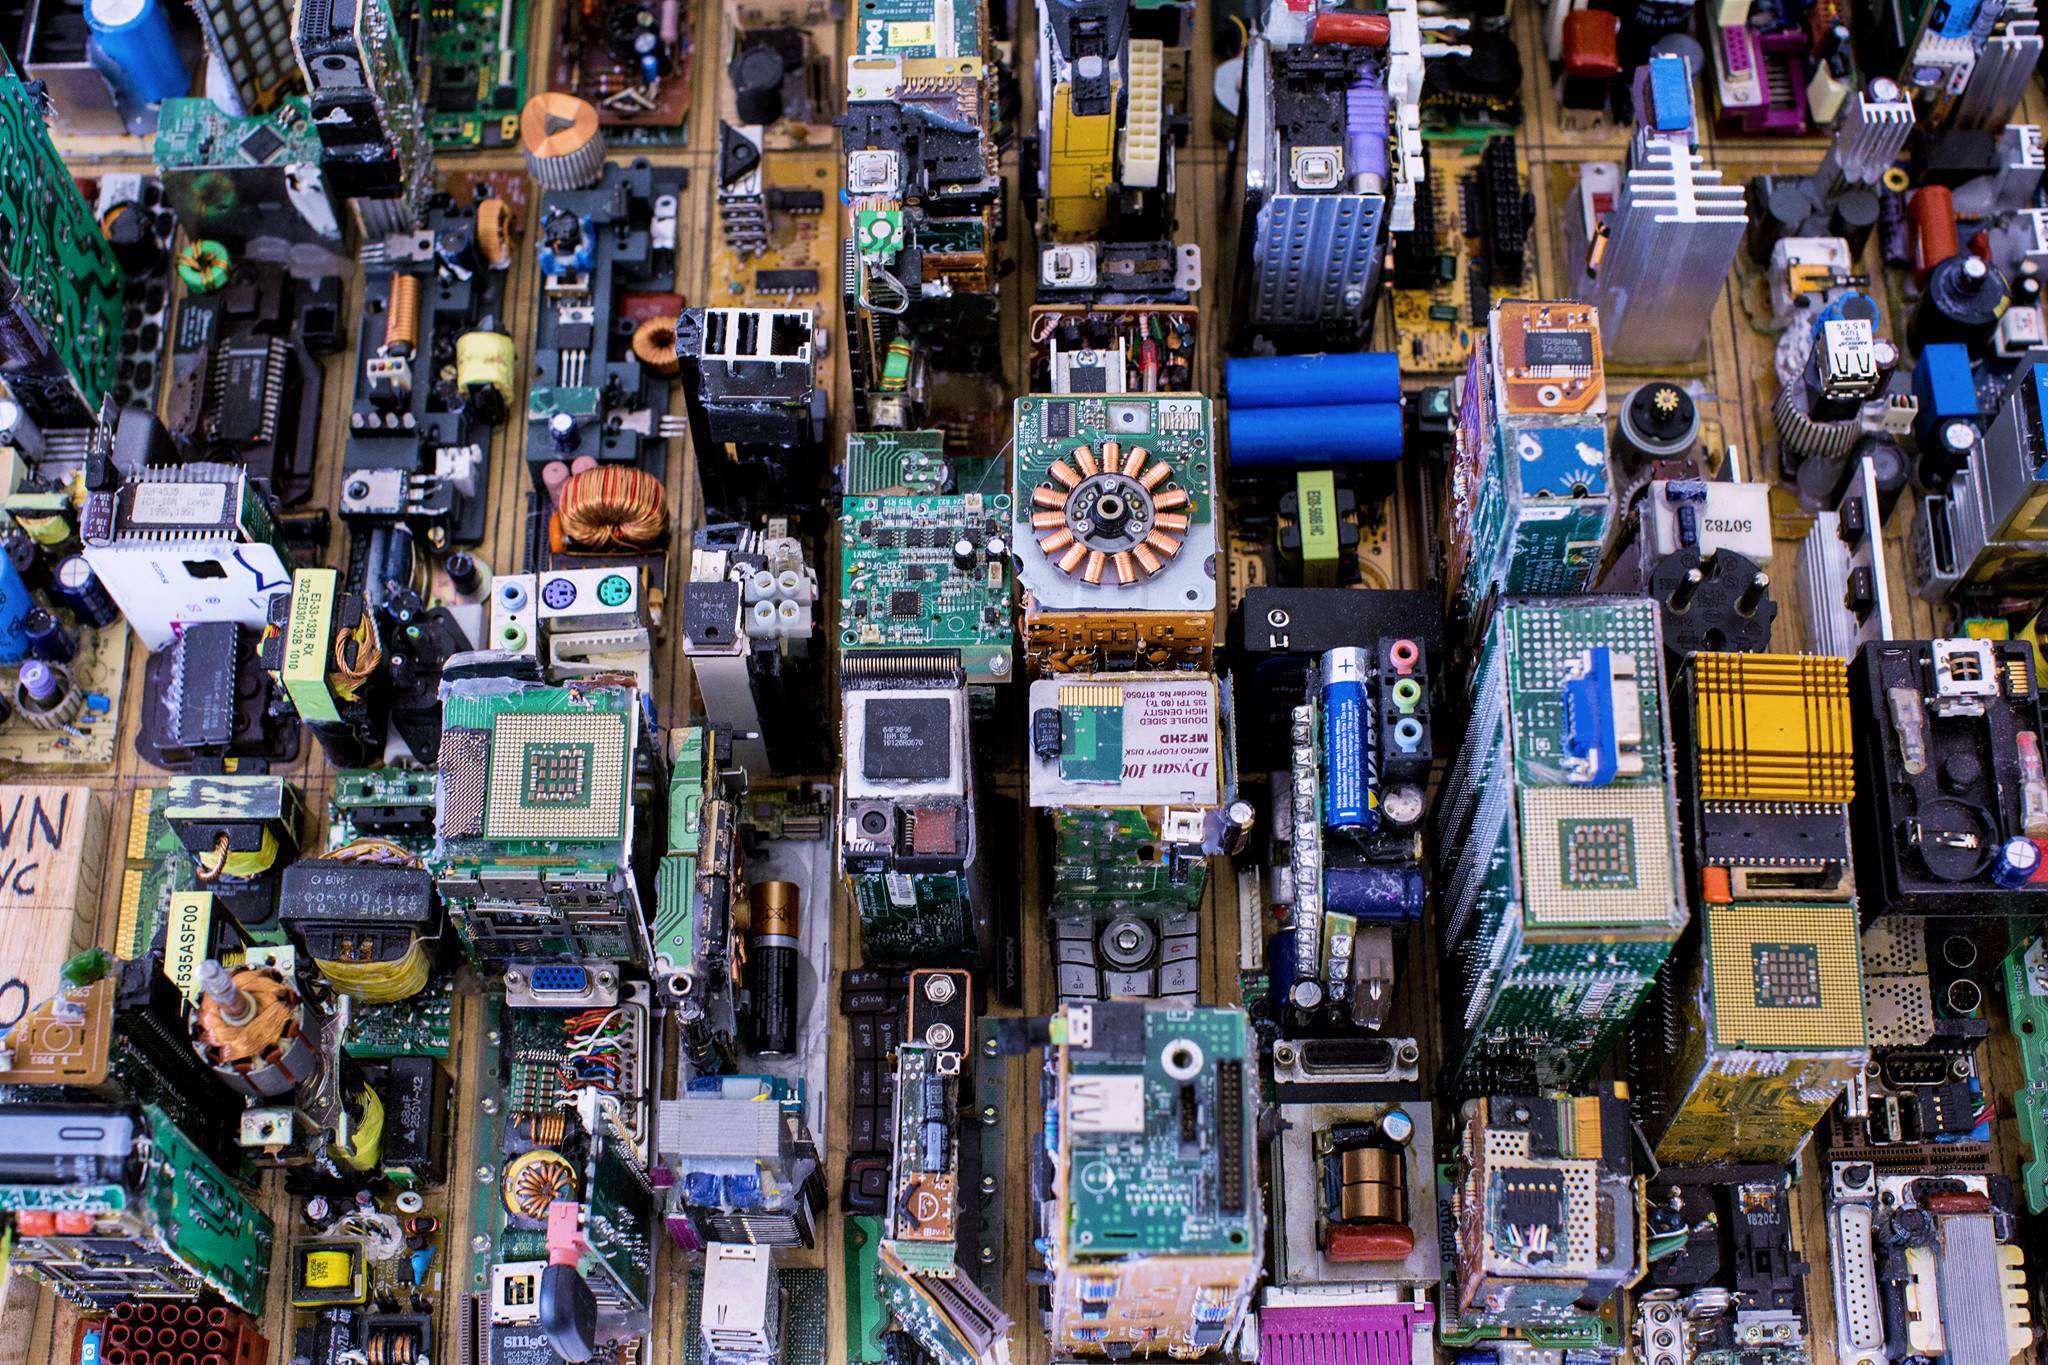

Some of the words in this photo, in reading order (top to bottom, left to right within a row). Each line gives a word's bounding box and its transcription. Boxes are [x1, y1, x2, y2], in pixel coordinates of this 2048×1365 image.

[1541, 338, 1578, 346] TOSHIBA
[1705, 519, 1752, 533] 50782
[303, 643, 314, 656] RX
[288, 650, 301, 670] 1010
[1126, 691, 1155, 699] 817050
[1156, 690, 1171, 698] No.
[1146, 699, 1158, 707] Tr.)
[1161, 699, 1174, 707] (80
[1143, 709, 1183, 717] DENSITY
[1185, 708, 1208, 716] HIGH
[1139, 717, 1168, 726] SIDED
[1170, 716, 1208, 725] DOUBLE
[1159, 733, 1208, 744] MF2HD
[1124, 748, 1145, 757] DISK
[1146, 748, 1178, 756] FLOPPY
[1180, 747, 1208, 755] MICRO
[1151, 759, 1209, 778] Dysan
[1005, 935, 1016, 989] NOKIA
[1122, 985, 1136, 993] abc
[851, 997, 859, 1008] 9
[862, 1033, 870, 1047] def
[861, 1071, 869, 1086] abc
